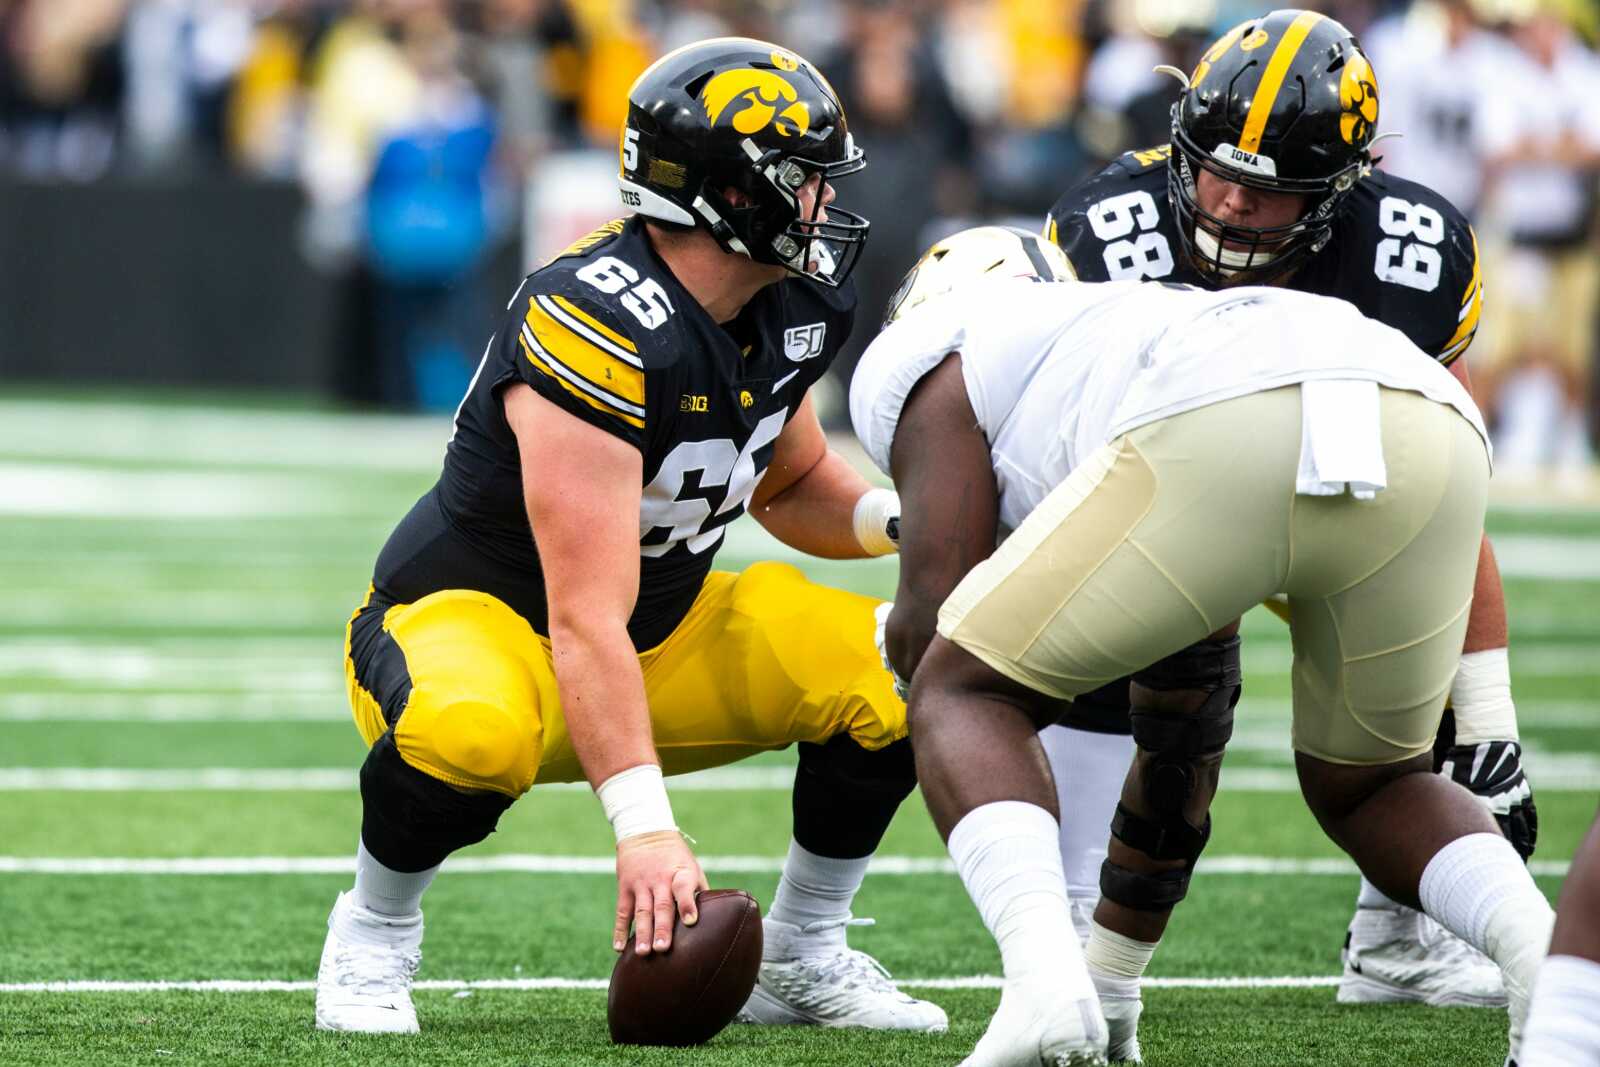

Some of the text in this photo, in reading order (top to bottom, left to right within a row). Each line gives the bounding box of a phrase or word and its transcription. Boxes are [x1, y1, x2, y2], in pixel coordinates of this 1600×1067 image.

[1231, 148, 1259, 167] IOWA
[1087, 190, 1175, 281] 68
[1374, 196, 1445, 292] 68
[575, 256, 676, 330] 65
[785, 323, 826, 361] 150
[640, 406, 789, 558] 65
